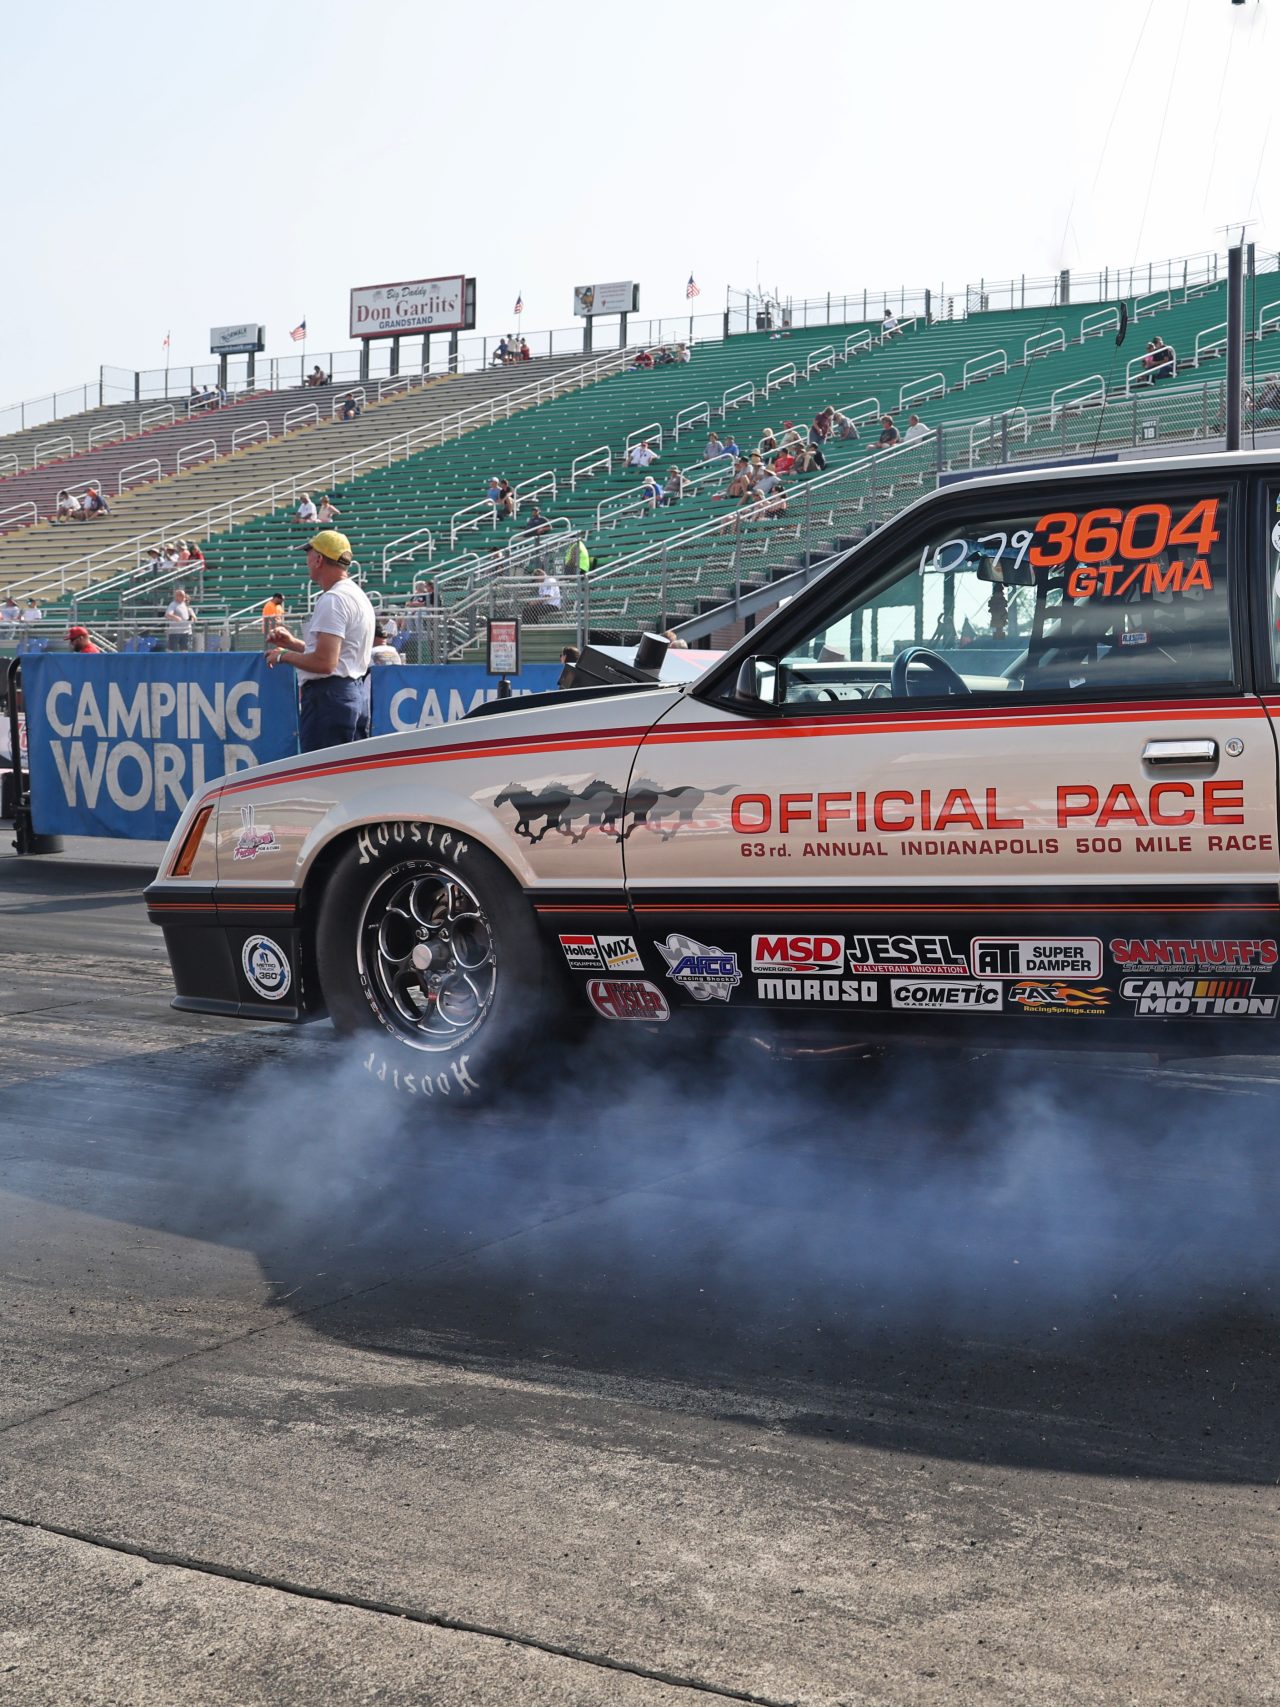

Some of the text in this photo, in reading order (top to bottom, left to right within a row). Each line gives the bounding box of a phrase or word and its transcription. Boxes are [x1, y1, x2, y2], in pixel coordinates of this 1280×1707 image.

[387, 286, 427, 301] Big Daddy
[357, 304, 391, 322] Don
[379, 316, 433, 329] GRANDSTAND
[1029, 498, 1220, 567] 3604
[1068, 559, 1213, 598] GT/MA
[45, 680, 262, 741] CAMPING
[731, 788, 1024, 834] OFFICIAL
[1057, 780, 1244, 828] PACE
[357, 821, 468, 865] Hoosier
[802, 841, 888, 857] ANNUAL
[901, 839, 1059, 856] INDIANAPOLIS
[1076, 838, 1121, 853] 500
[1136, 836, 1191, 852] MILE
[1208, 834, 1272, 851] RACE
[563, 945, 598, 959] Holley
[602, 938, 632, 959] WIX
[755, 937, 842, 962] MSD
[847, 936, 965, 965] JESEL
[1032, 946, 1084, 959] SUPER
[1110, 939, 1278, 965] SANTHUFF'S
[609, 957, 639, 969] FILTERS
[671, 956, 735, 975] AFCO
[978, 943, 1020, 974] ATI
[1026, 959, 1092, 972] DAMPER
[259, 972, 278, 980] 360
[856, 965, 964, 974] VALVETRAIN INNOVATION
[758, 979, 878, 1002] MOROSO
[894, 985, 1000, 1004] COMETIC
[1008, 986, 1068, 1003] PAC
[1123, 980, 1195, 997] CAM
[1023, 1005, 1105, 1015] RacingSprings.com
[1139, 997, 1275, 1014] MOTION
